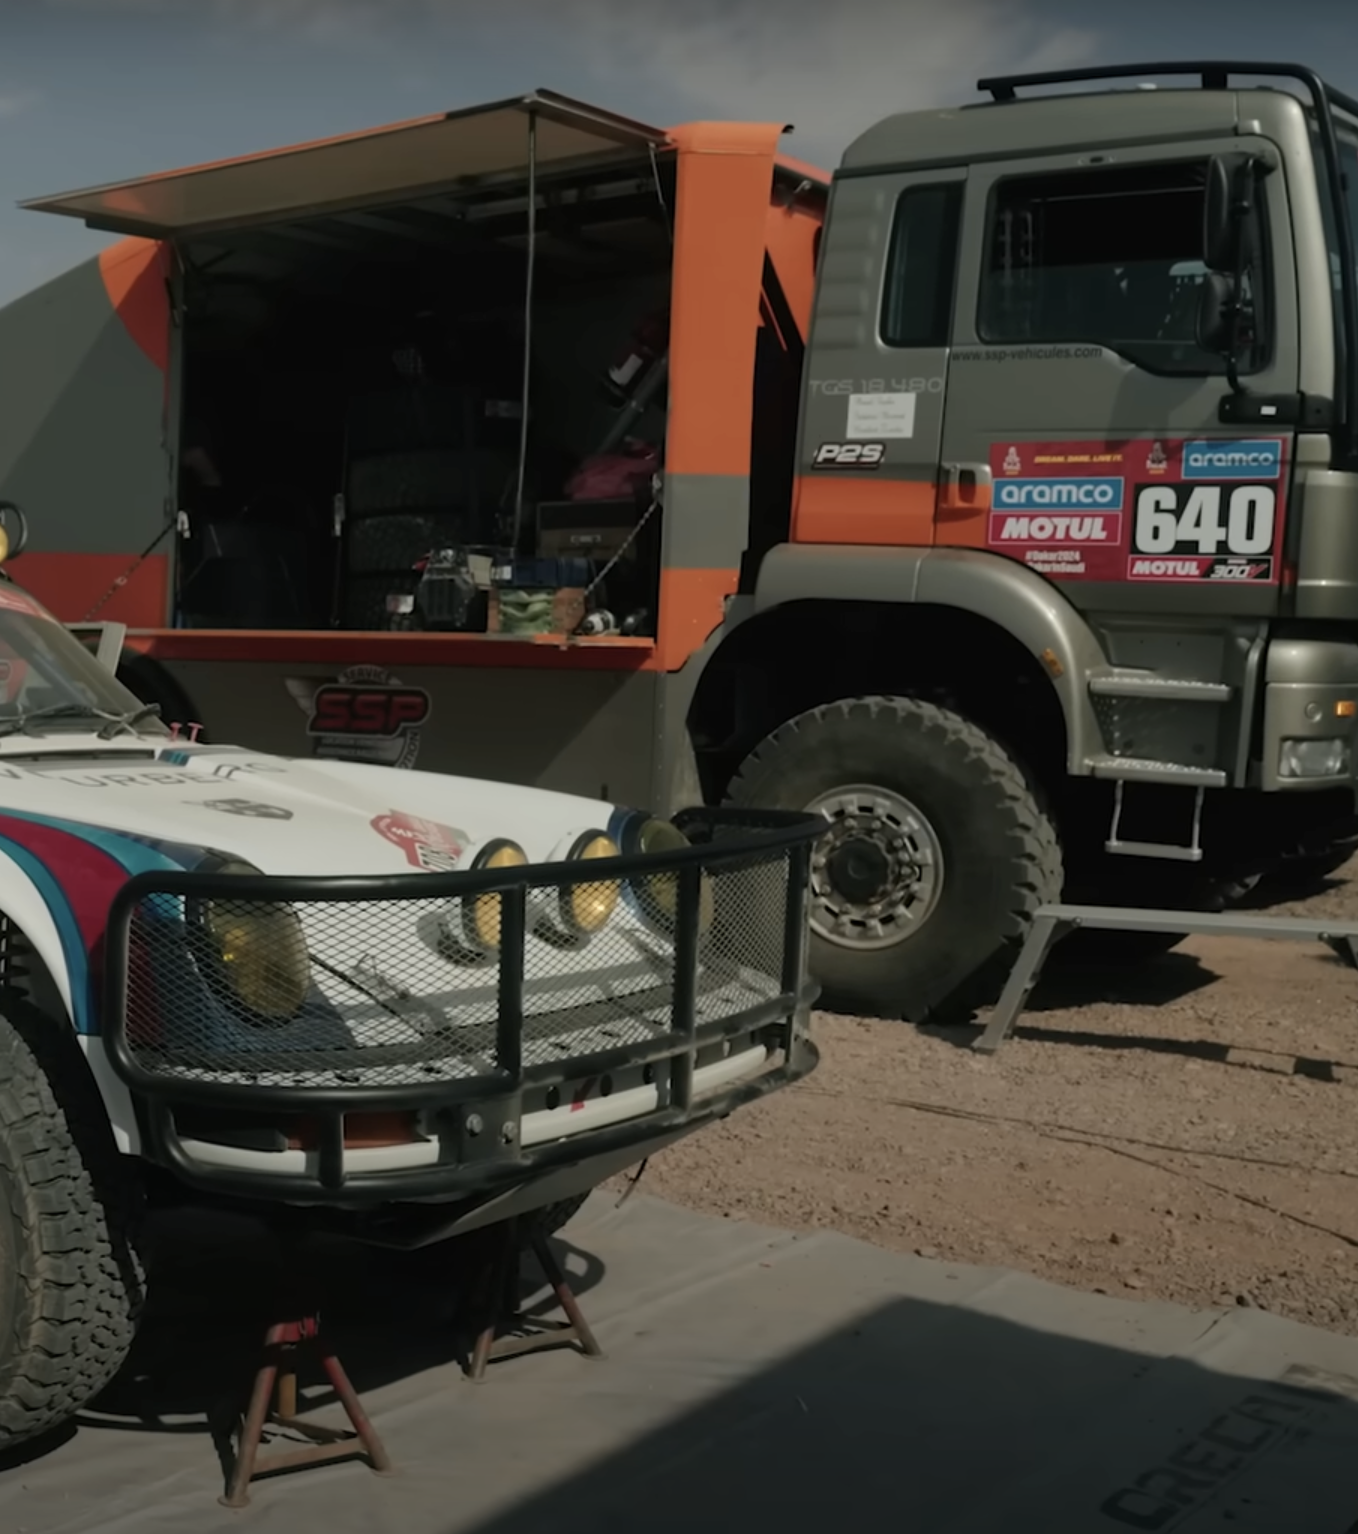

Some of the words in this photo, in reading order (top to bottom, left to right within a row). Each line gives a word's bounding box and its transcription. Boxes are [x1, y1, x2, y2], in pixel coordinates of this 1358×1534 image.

[952, 346, 1103, 363] www.ssp-vehicules.com
[810, 379, 854, 396] TGS
[816, 444, 884, 463] P2S
[1189, 452, 1274, 467] aramco
[1001, 484, 1113, 504] aramco
[1000, 517, 1107, 541] MOTUL
[1135, 485, 1275, 555] 640
[1132, 560, 1200, 576] MOTUL
[315, 693, 426, 731] SSP
